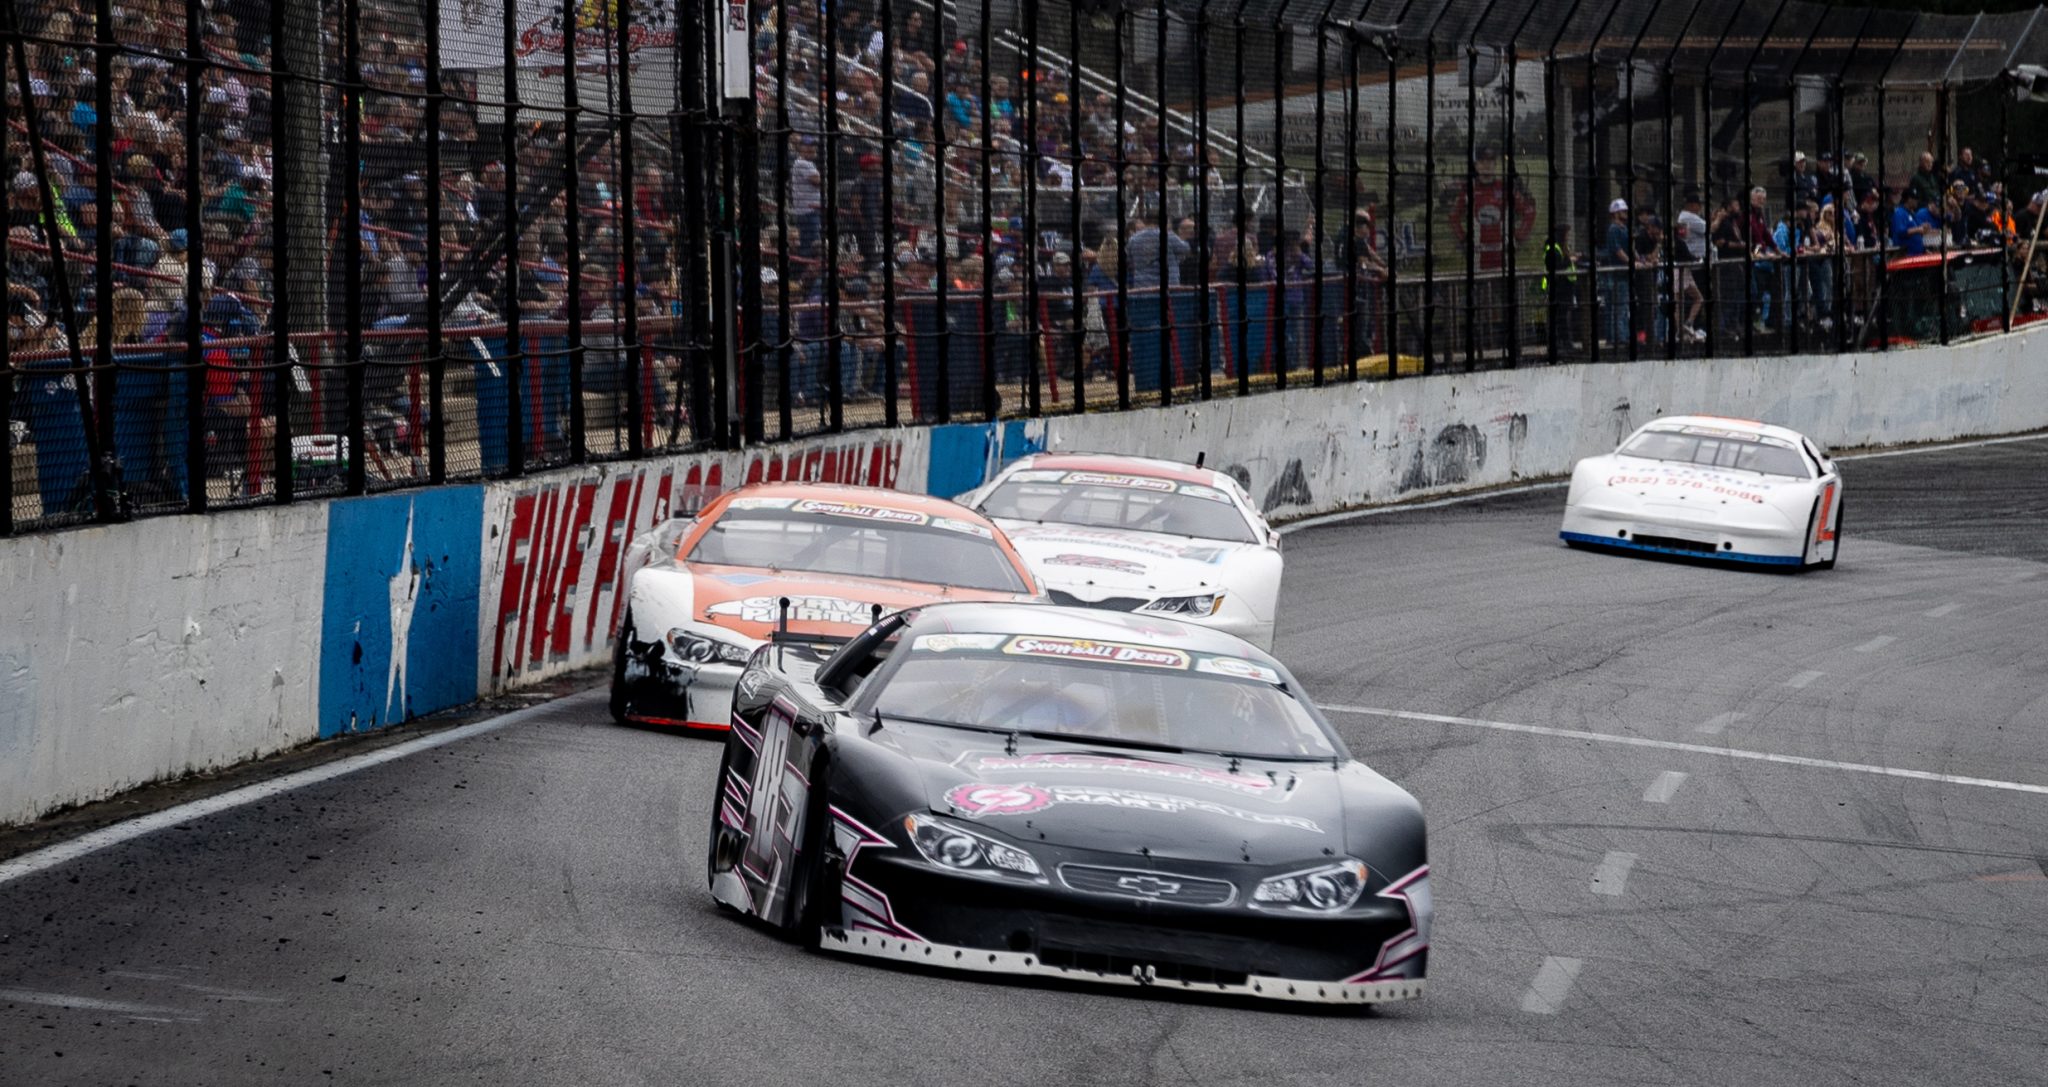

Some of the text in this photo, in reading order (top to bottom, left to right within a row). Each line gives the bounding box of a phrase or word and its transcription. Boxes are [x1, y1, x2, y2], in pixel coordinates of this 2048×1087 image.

[1607, 475, 1659, 487] (352)
[1015, 639, 1178, 665] SNOWBALL DERBY
[1055, 793, 1175, 812] MART
